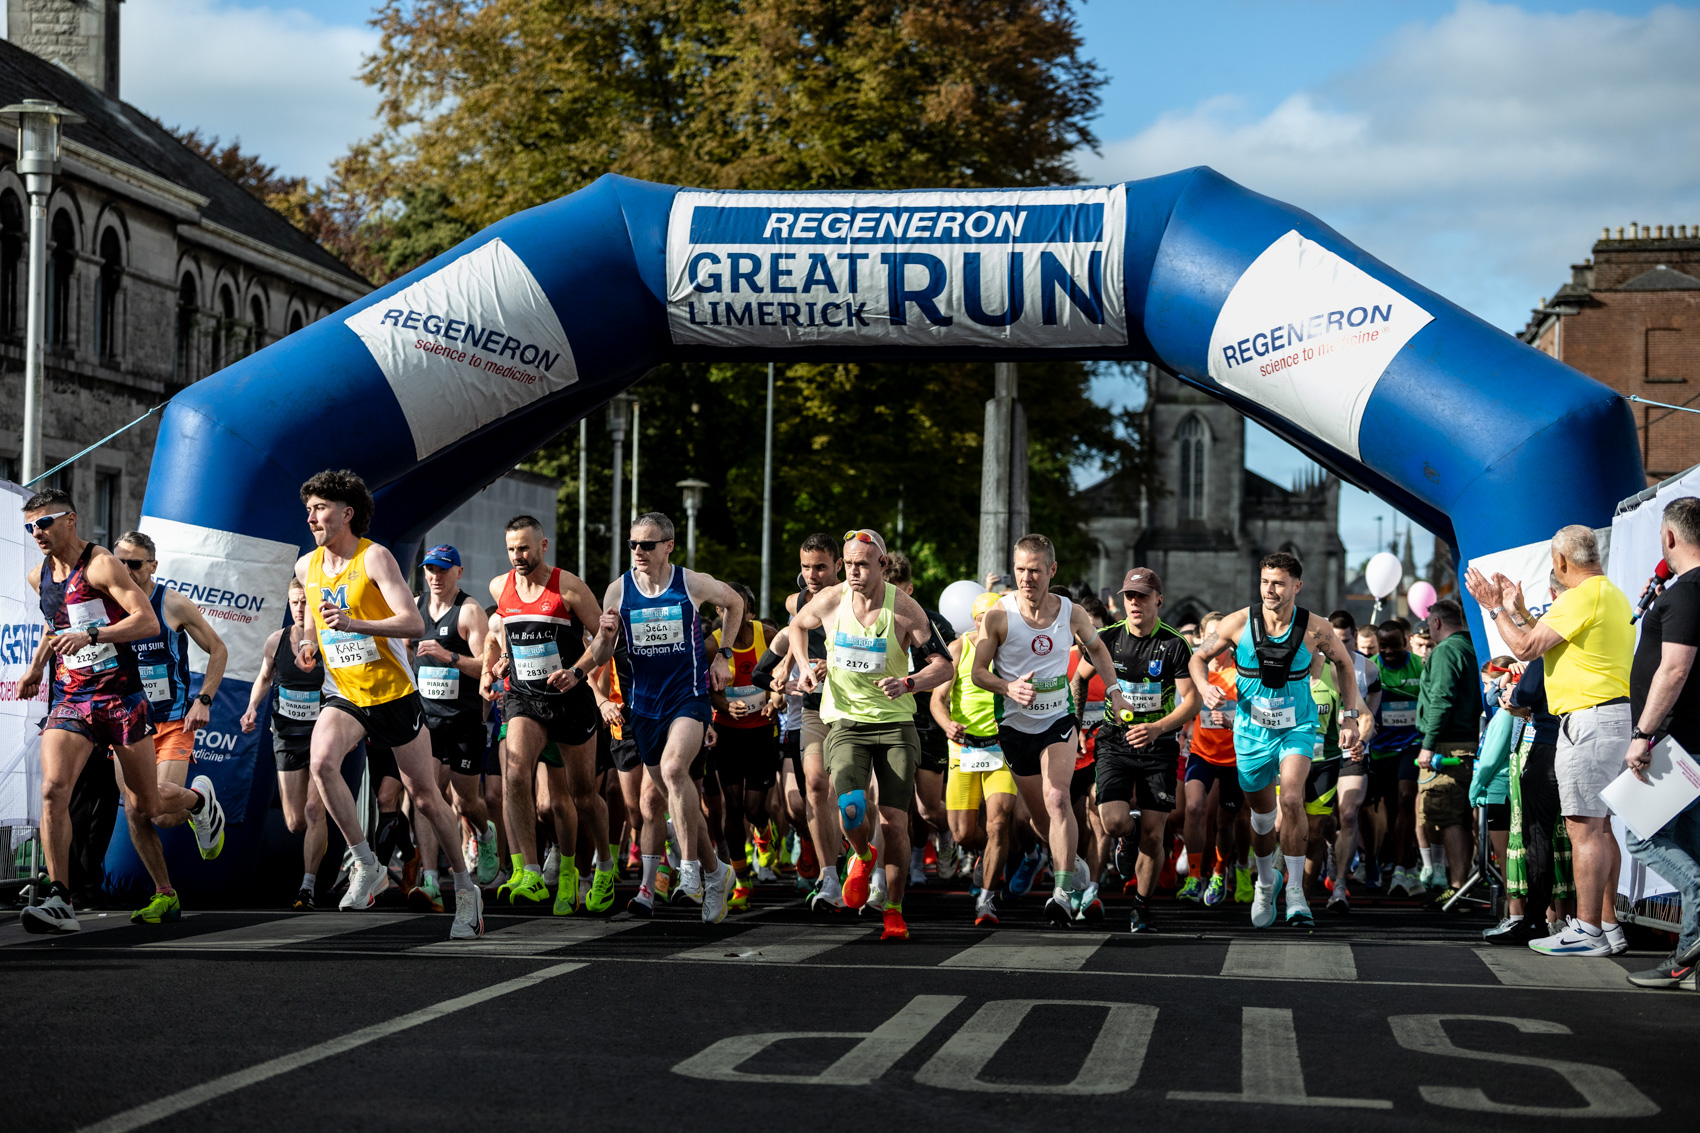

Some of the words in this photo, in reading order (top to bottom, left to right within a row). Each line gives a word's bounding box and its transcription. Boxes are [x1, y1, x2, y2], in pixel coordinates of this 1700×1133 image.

[762, 210, 1028, 238] REGENERON
[687, 252, 870, 294] GREAT
[881, 249, 1106, 327] RUN
[688, 301, 870, 328] LIMERICK
[380, 308, 561, 372] REGENERON
[1222, 304, 1393, 368] REGENERON
[414, 338, 467, 363] science
[468, 354, 482, 368] to
[1259, 353, 1300, 377] science
[1302, 347, 1314, 362] to
[148, 642, 164, 650] SUIR
[646, 634, 668, 642] 2043
[672, 642, 686, 652] AC
[76, 652, 98, 663] 2225
[335, 642, 364, 654] KARL
[340, 653, 362, 663] 1975
[846, 660, 869, 669] 2176
[527, 668, 548, 676] 2836
[670, 993, 1662, 1119] STOP
